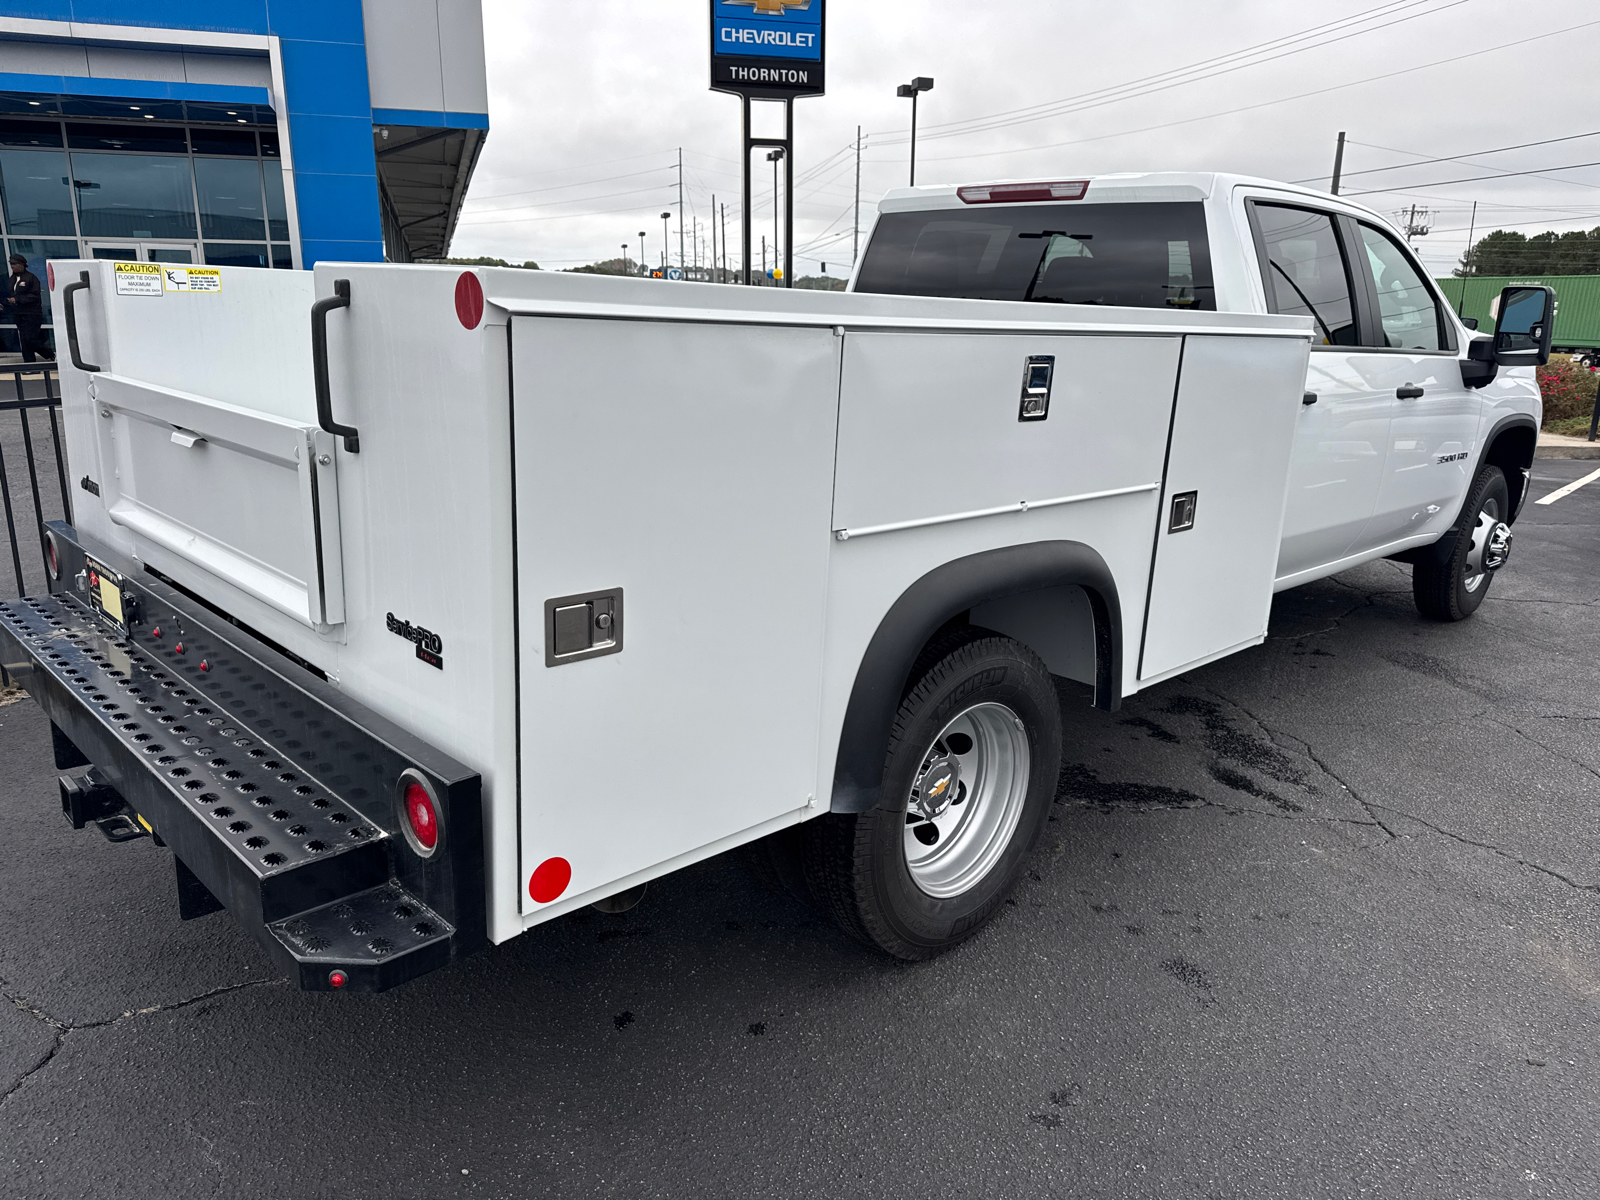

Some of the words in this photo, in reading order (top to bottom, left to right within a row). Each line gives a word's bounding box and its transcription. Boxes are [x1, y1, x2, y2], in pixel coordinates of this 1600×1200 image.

[721, 27, 815, 47] CHEVROLET
[730, 66, 808, 83] THORNTON
[123, 264, 160, 273] CAUTION
[1437, 454, 1456, 464] 3500
[386, 612, 442, 654] ServicePRO
[938, 669, 1006, 717] MICHELIN
[907, 918, 946, 938] PRIMACY
